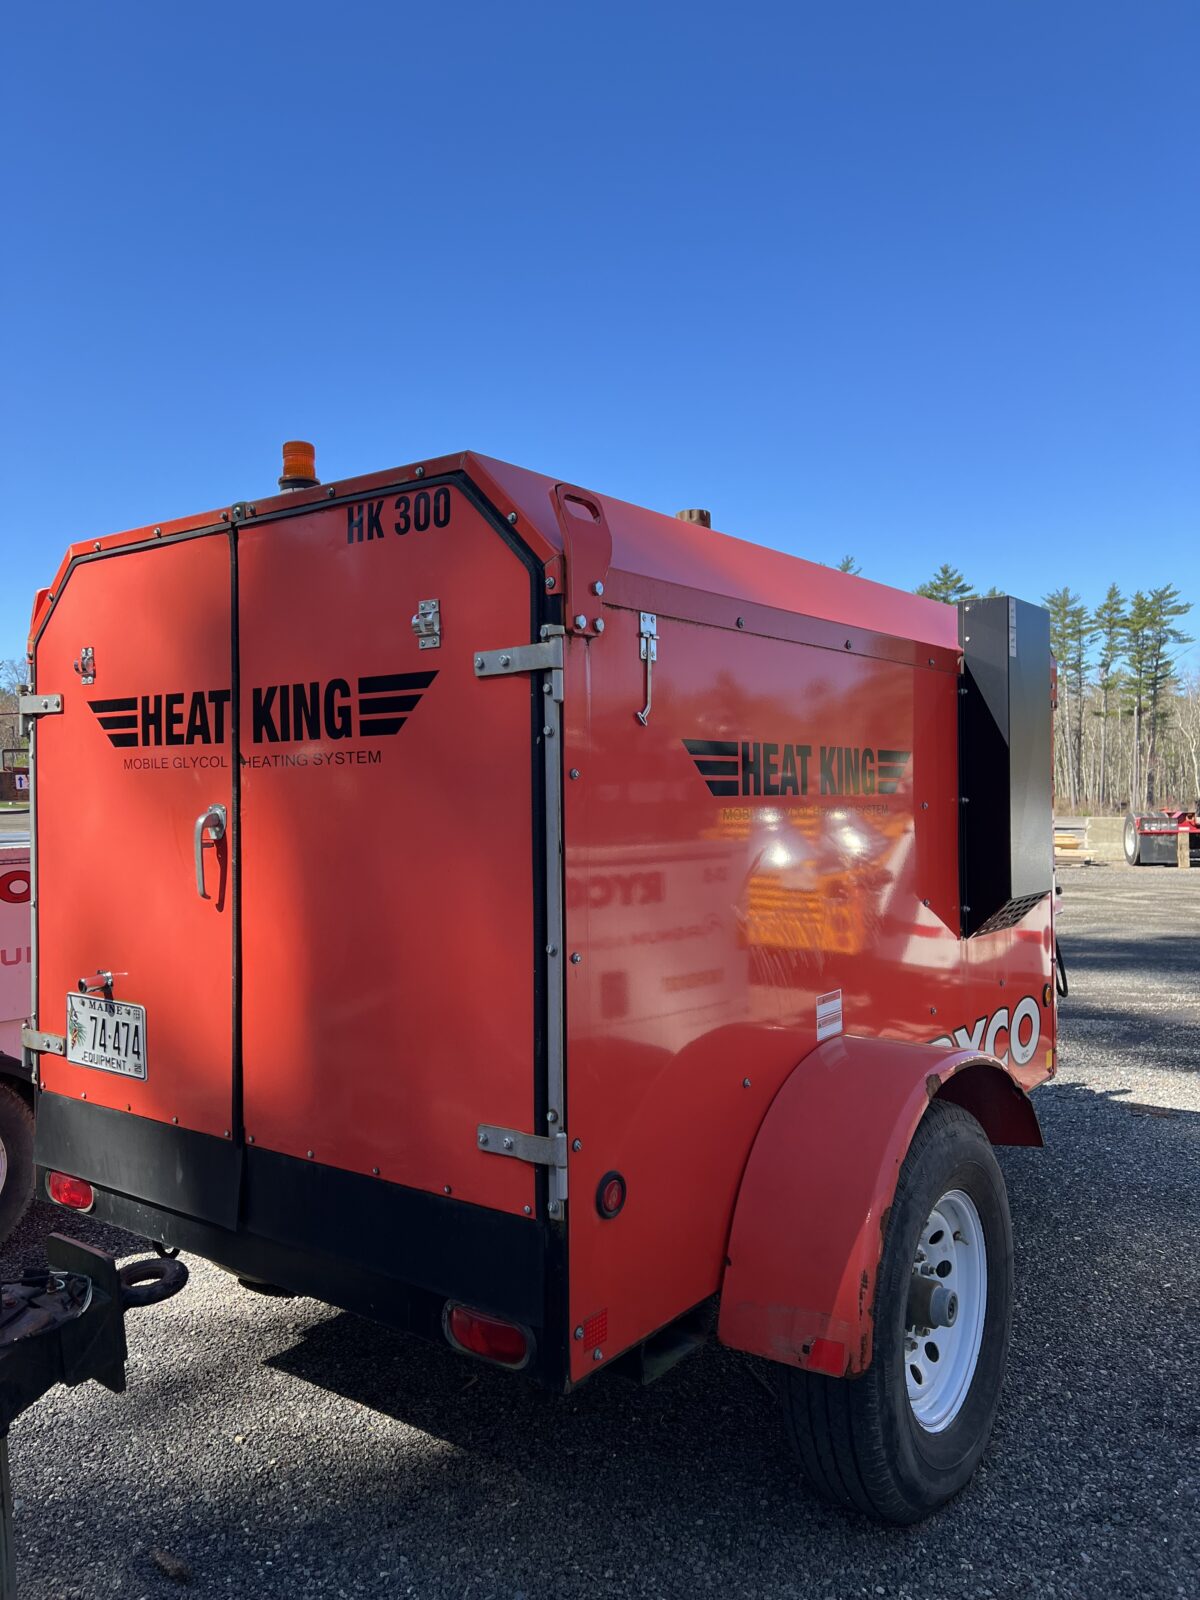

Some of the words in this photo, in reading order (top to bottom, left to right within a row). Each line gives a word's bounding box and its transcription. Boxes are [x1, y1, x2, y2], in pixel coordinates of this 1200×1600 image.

[347, 500, 385, 544] HK
[394, 487, 451, 536] 300
[141, 689, 231, 747] HEAT
[252, 678, 352, 744] KING
[123, 757, 169, 770] MOBILE
[172, 756, 228, 770] GLYCOL
[241, 752, 309, 769] HEATING
[312, 750, 382, 766] SYSTEM
[741, 742, 812, 796] HEAT
[820, 746, 875, 796] KING
[88, 1000, 123, 1016] MAINE
[928, 995, 1041, 1067] YCO
[83, 1051, 127, 1071] EQUIPMENT
